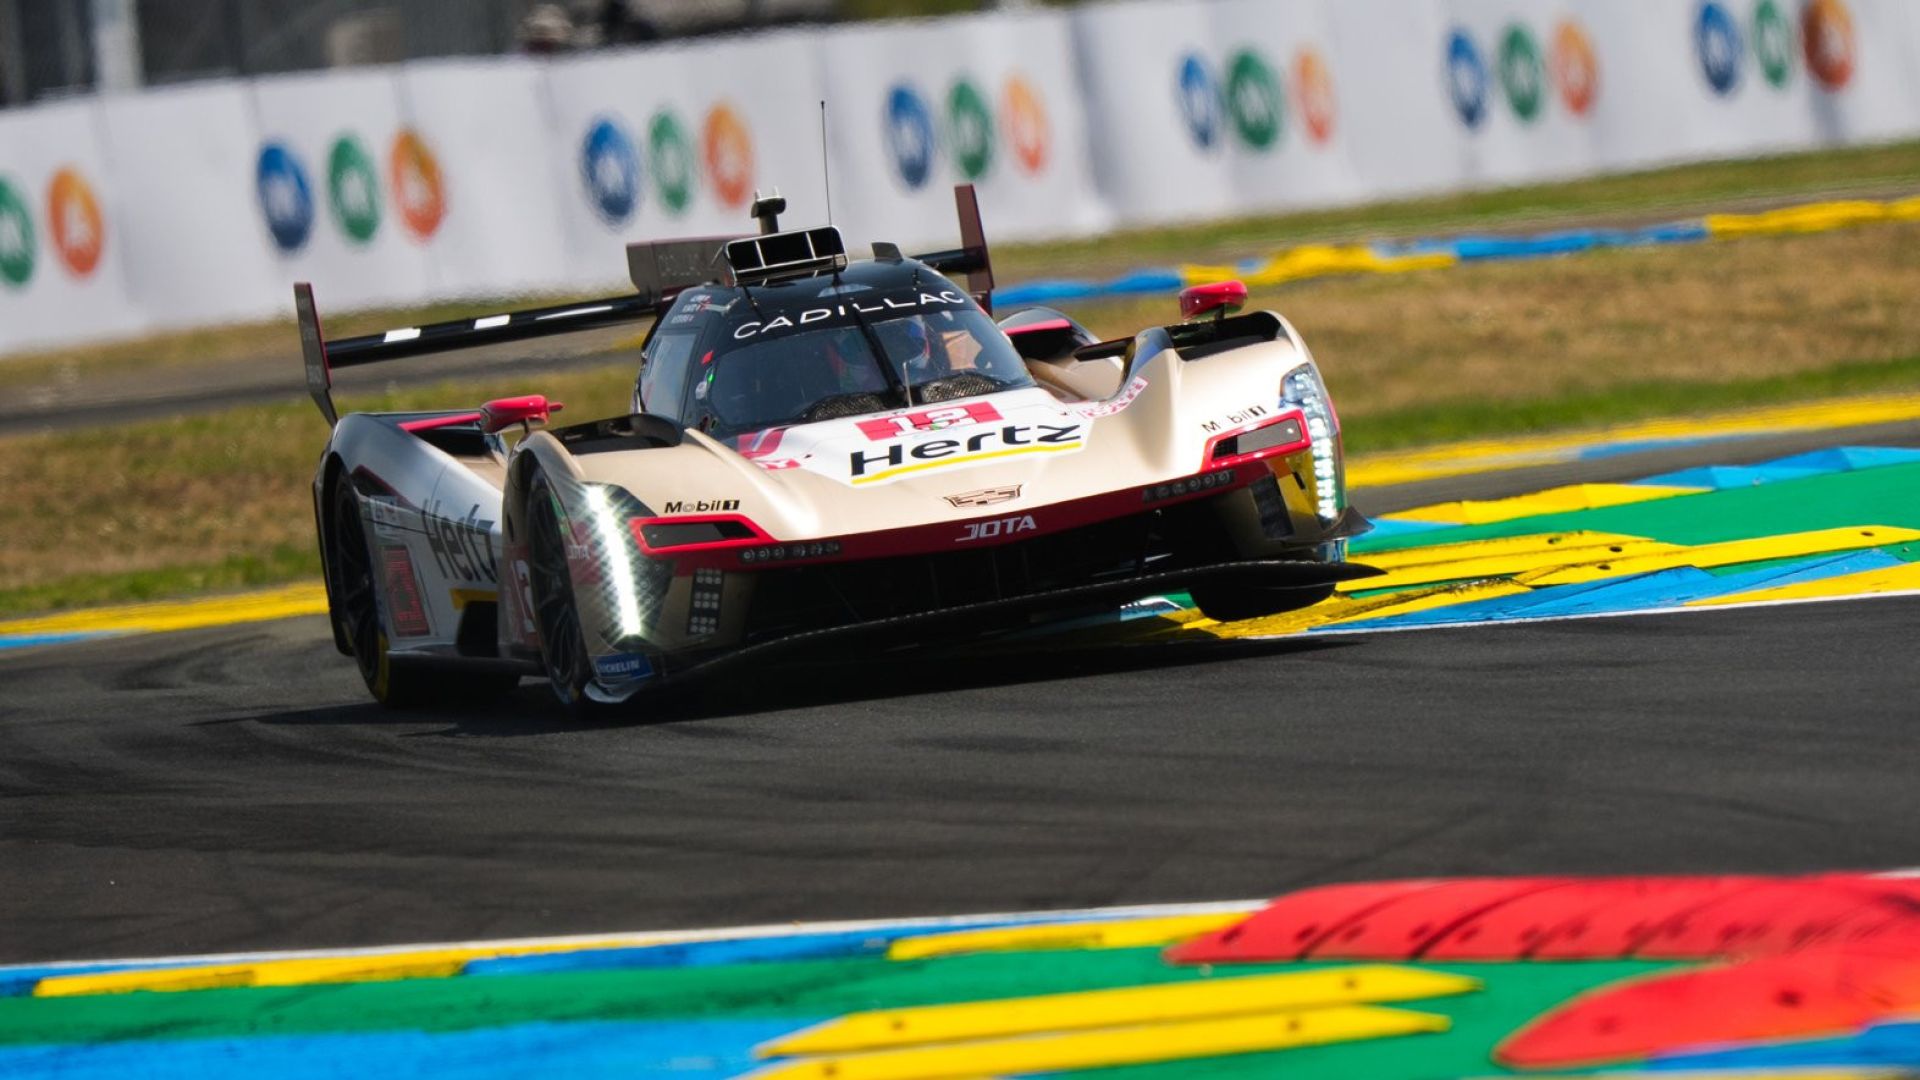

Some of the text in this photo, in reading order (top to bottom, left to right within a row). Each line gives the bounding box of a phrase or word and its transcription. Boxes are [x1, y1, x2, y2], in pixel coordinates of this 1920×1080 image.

[734, 291, 964, 339] CADILLAC
[1201, 409, 1251, 433] Mbil
[850, 424, 1082, 476] Hertz
[421, 498, 497, 583] Hertz
[955, 515, 1037, 542] JOTA
